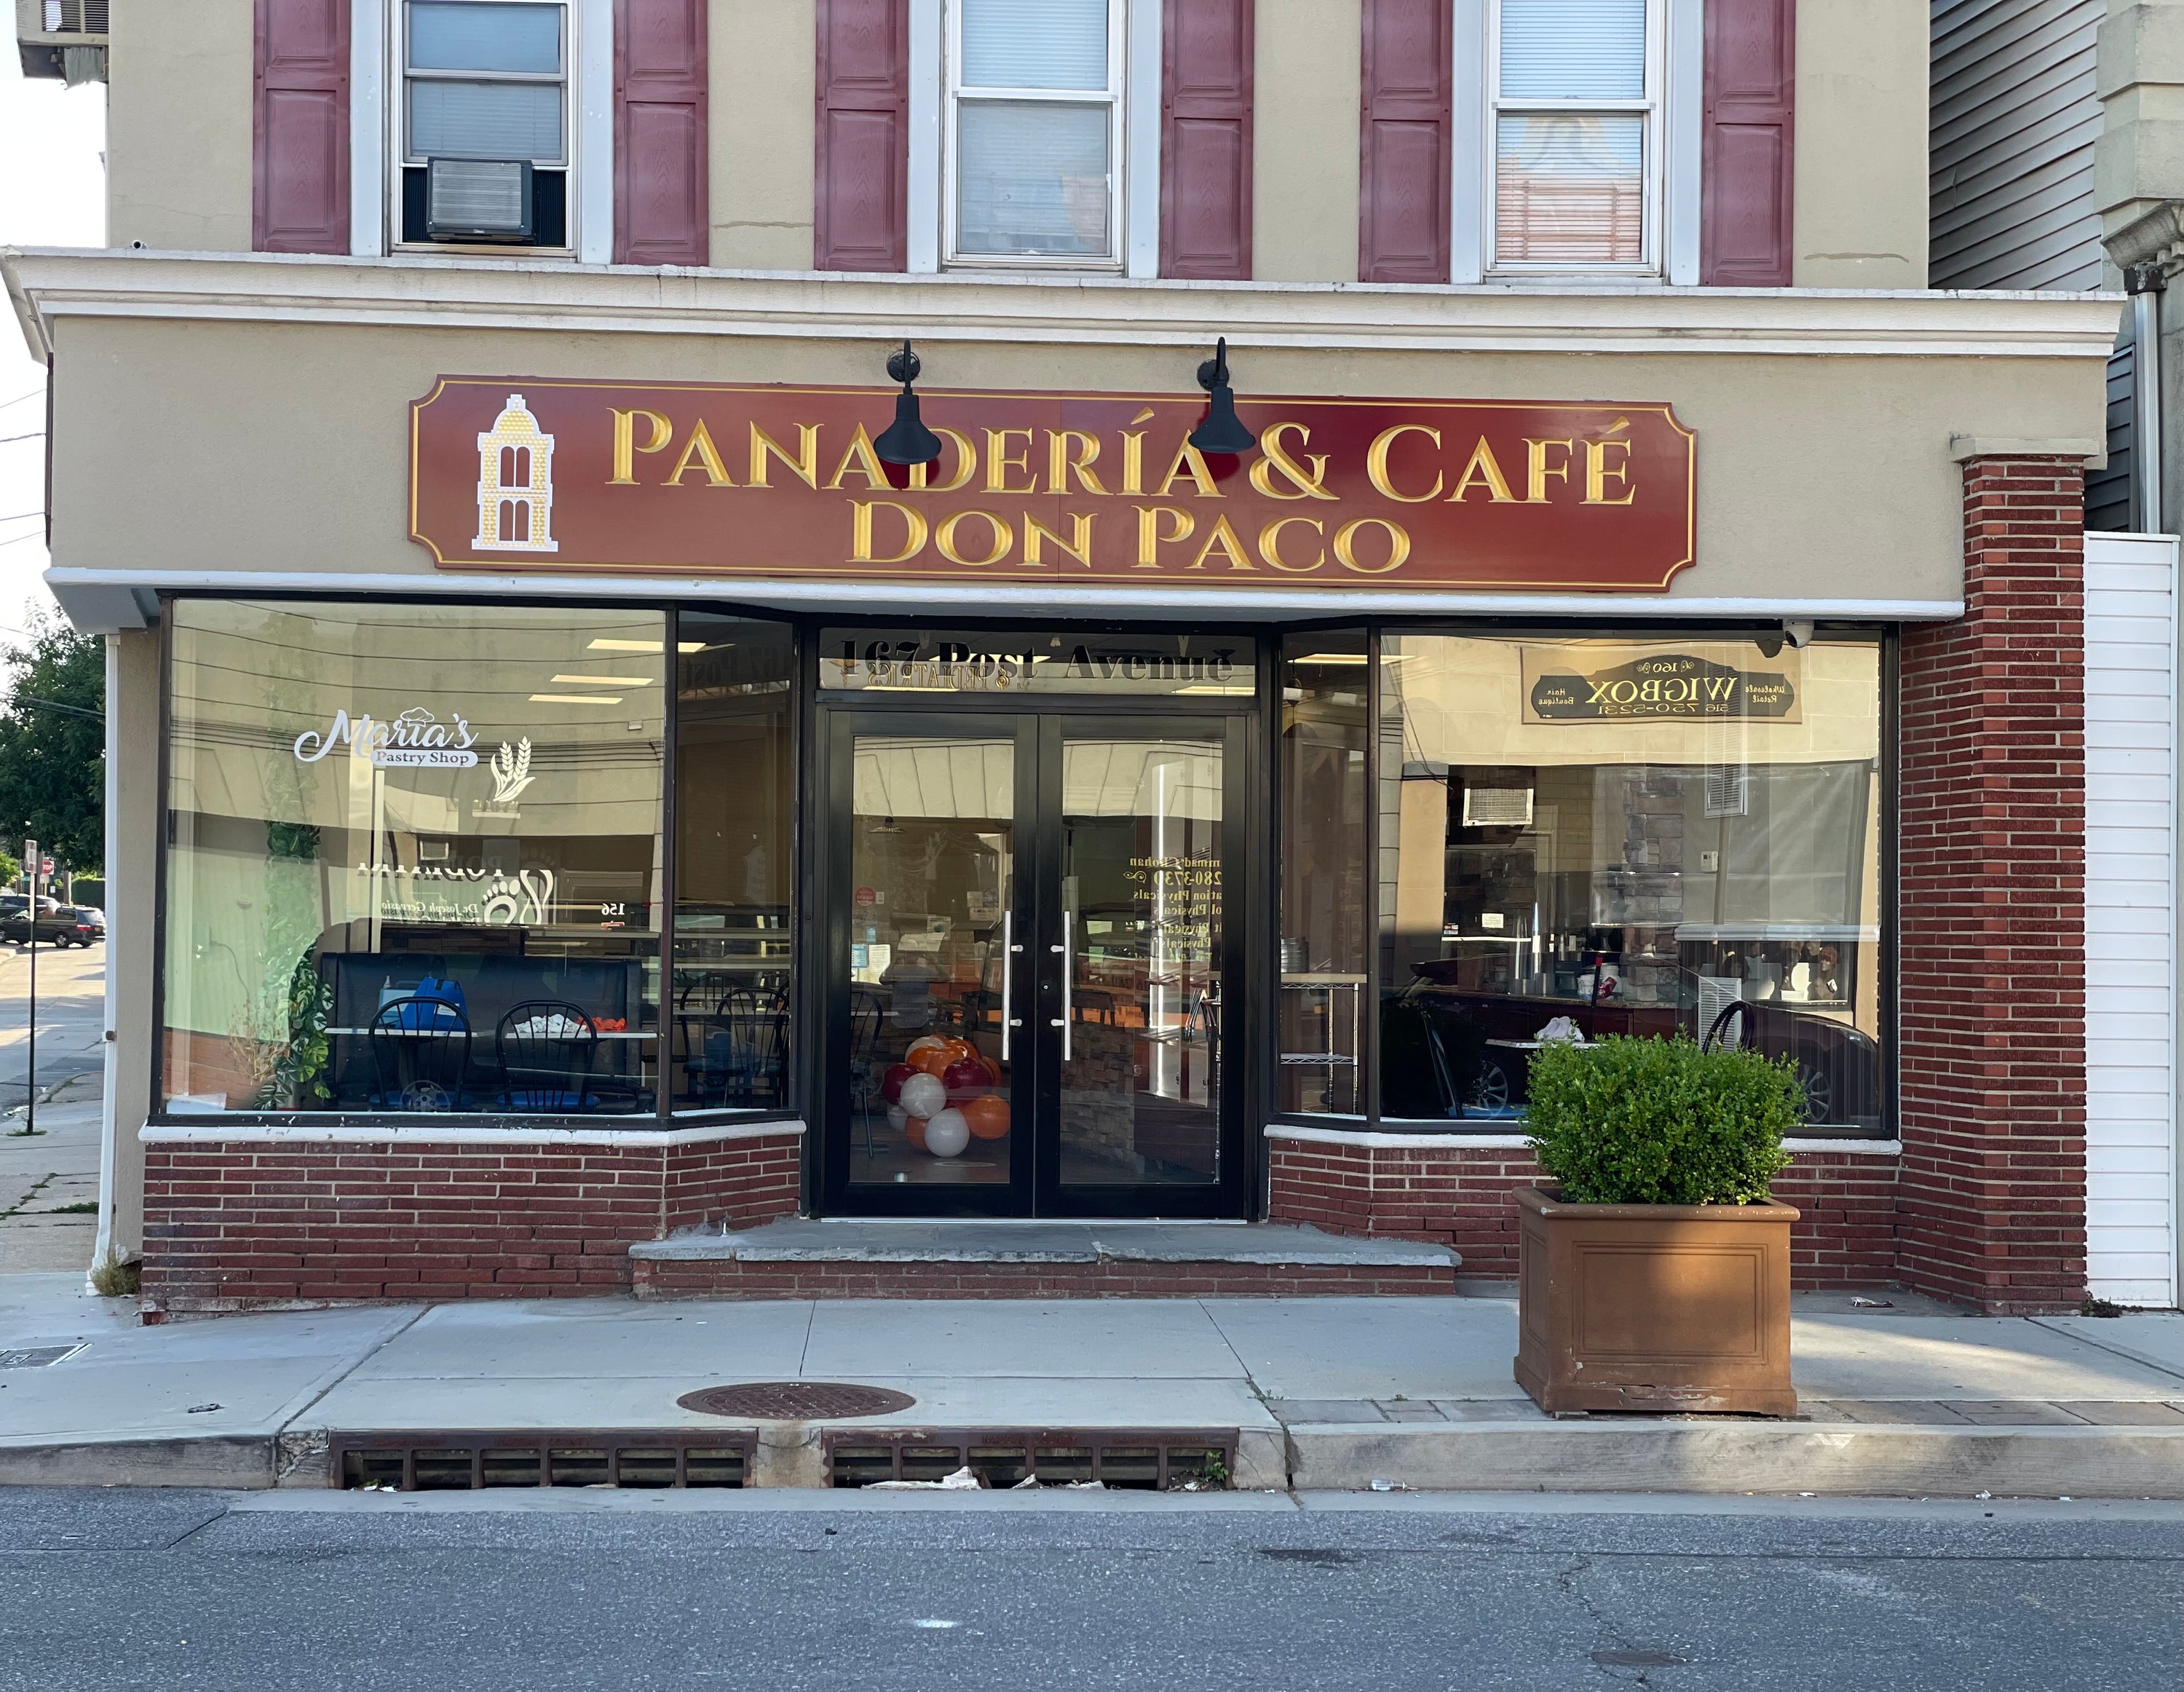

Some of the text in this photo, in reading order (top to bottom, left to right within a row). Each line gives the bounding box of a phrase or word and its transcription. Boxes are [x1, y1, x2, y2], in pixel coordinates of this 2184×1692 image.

[606, 406, 1637, 505] PANADERÍA & CAFÉ
[845, 499, 1411, 574] DON PACO
[840, 640, 1234, 682] 167 Post Avenue
[294, 709, 479, 762] Maria's
[376, 751, 470, 767] Pastry Shop
